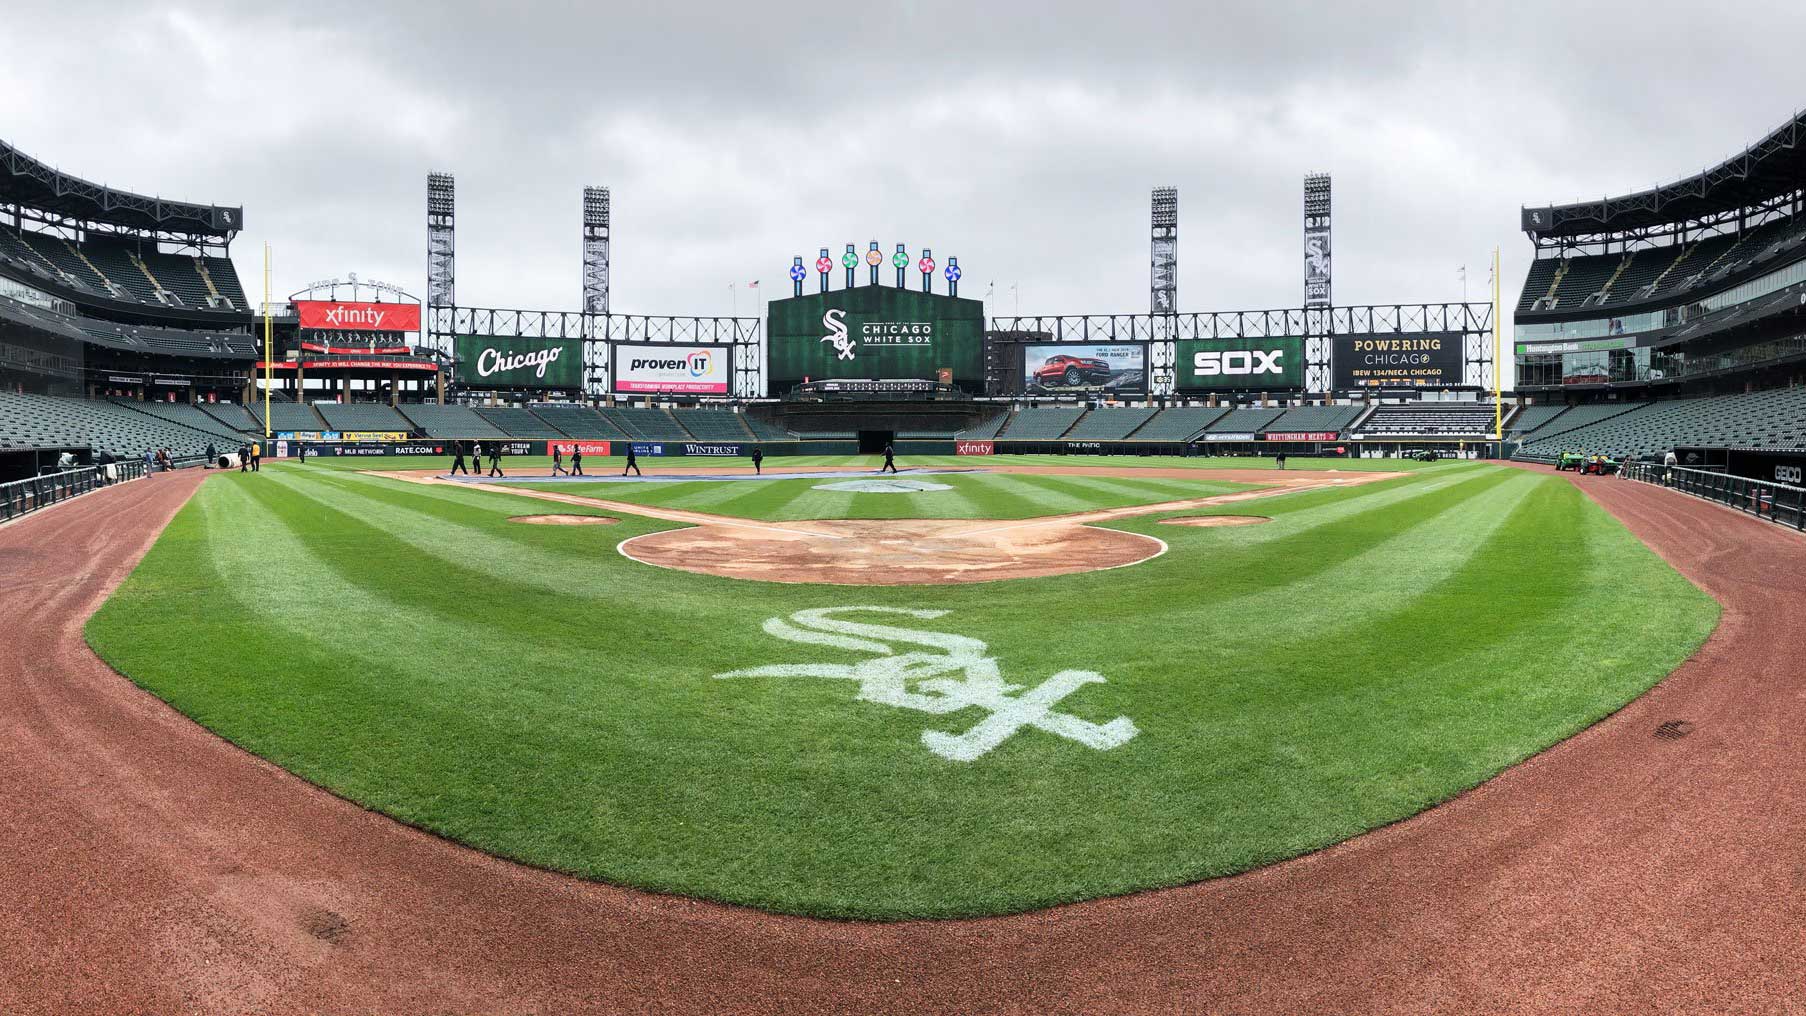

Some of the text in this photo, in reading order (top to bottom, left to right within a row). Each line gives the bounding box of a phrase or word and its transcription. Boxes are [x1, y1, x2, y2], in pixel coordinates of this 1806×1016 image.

[325, 306, 385, 327] xfinity
[862, 325, 932, 335] CHICAGO
[908, 335, 931, 343] SOX
[1354, 339, 1442, 352] POWERING
[1526, 343, 1563, 353] Huntington
[1563, 342, 1579, 351] Bank
[476, 346, 563, 378] Chicago
[630, 358, 708, 372] proven IT
[1193, 350, 1284, 376] SOX
[1410, 368, 1442, 376] CHICAGO
[1308, 433, 1326, 441] MEATS
[686, 444, 739, 455] WINTRUST
[959, 444, 992, 455] xfinity
[1775, 466, 1802, 482] GEICO
